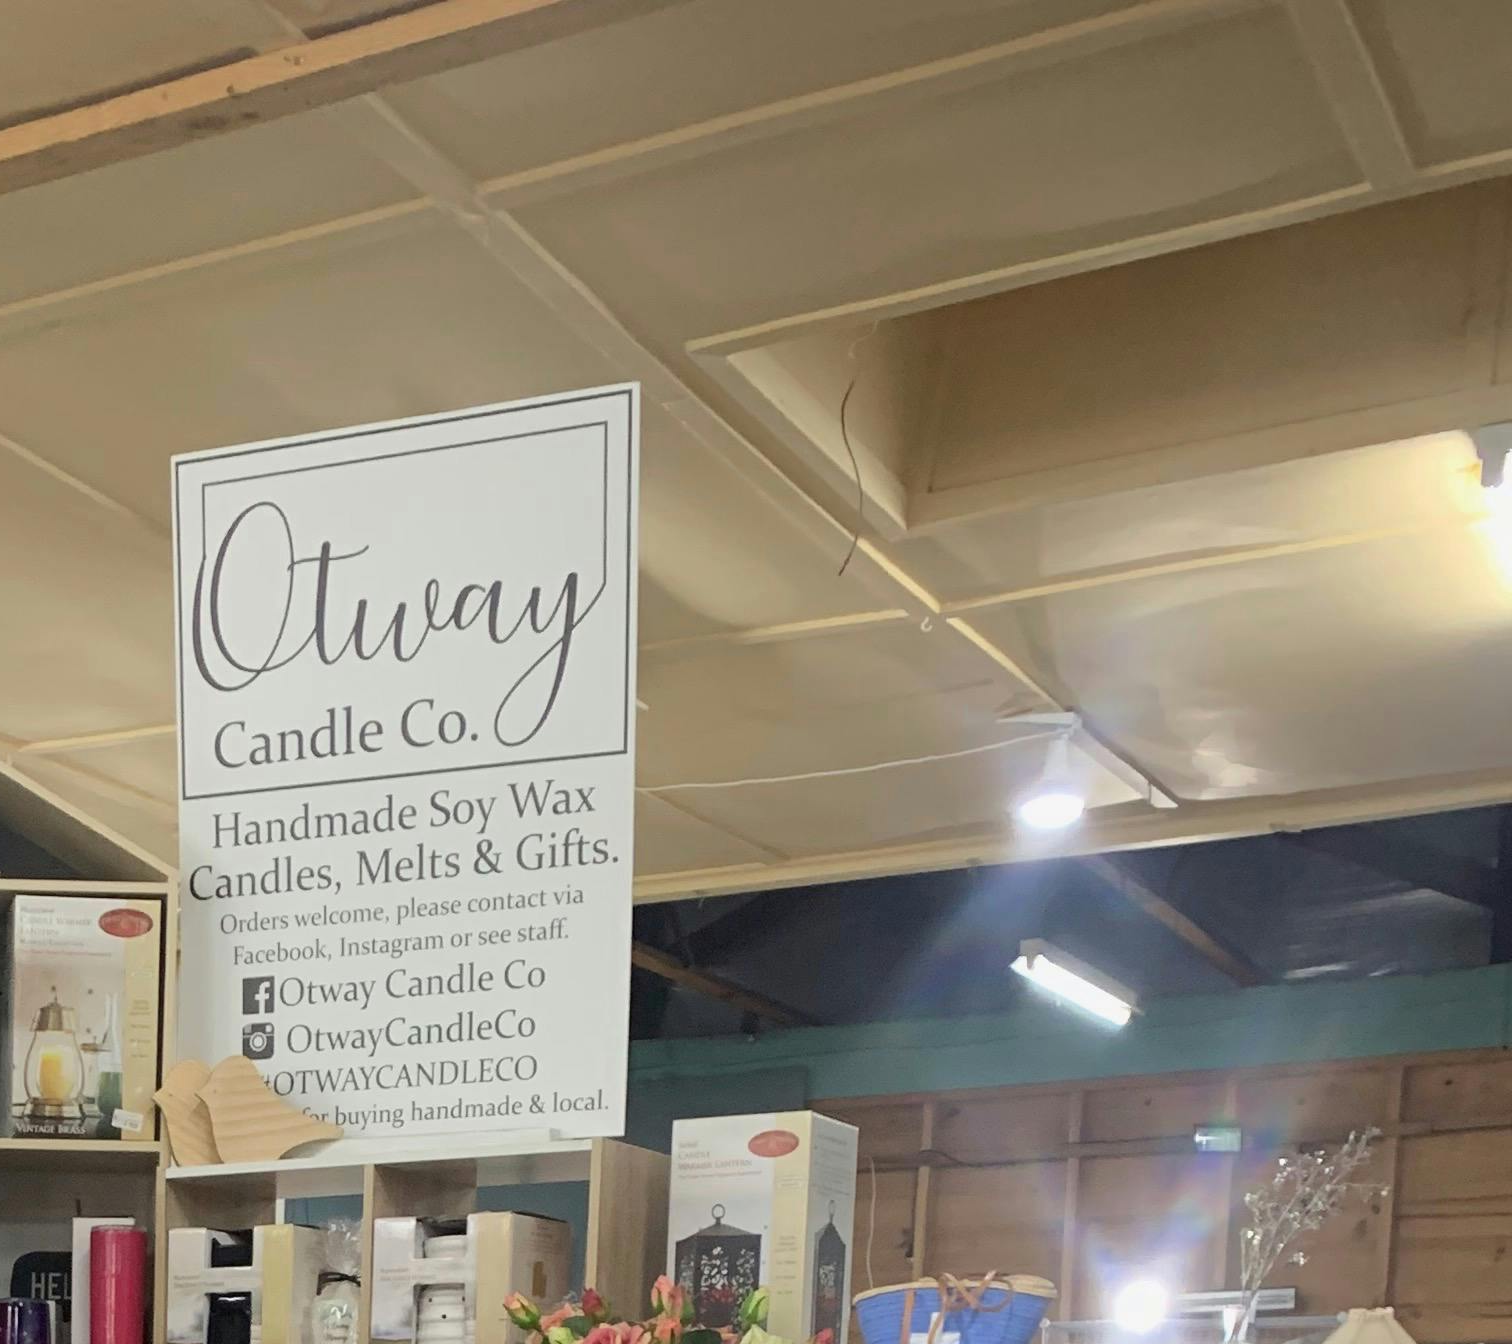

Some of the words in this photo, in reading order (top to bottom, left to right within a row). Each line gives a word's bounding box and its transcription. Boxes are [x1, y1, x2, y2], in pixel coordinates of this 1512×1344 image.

[193, 501, 588, 746] Otway
[214, 705, 384, 769] Candle
[400, 698, 478, 748] Co.
[212, 795, 418, 849] Handmade
[429, 789, 497, 834] Soy
[508, 779, 596, 817] Wax
[189, 855, 342, 902] Candles,
[356, 844, 461, 886] Melts
[473, 839, 502, 875] &
[516, 828, 619, 871] Gifts.
[219, 909, 289, 934] Orders
[294, 902, 391, 929] welcome,
[396, 896, 462, 925] please
[467, 890, 547, 913] contact
[554, 885, 585, 906] via
[232, 939, 332, 966] Facebook,
[339, 932, 444, 959] Instagram
[450, 931, 473, 947] or
[477, 928, 512, 945] see
[517, 918, 569, 943] staff.
[279, 976, 376, 1010] Otway
[384, 962, 494, 1000] Candle
[503, 958, 546, 990] Co
[286, 1008, 536, 1058] OtwayCandleCo
[334, 1103, 405, 1130] buying
[410, 1097, 523, 1122] handmade
[528, 1093, 546, 1115] &
[552, 1088, 610, 1114] local.
